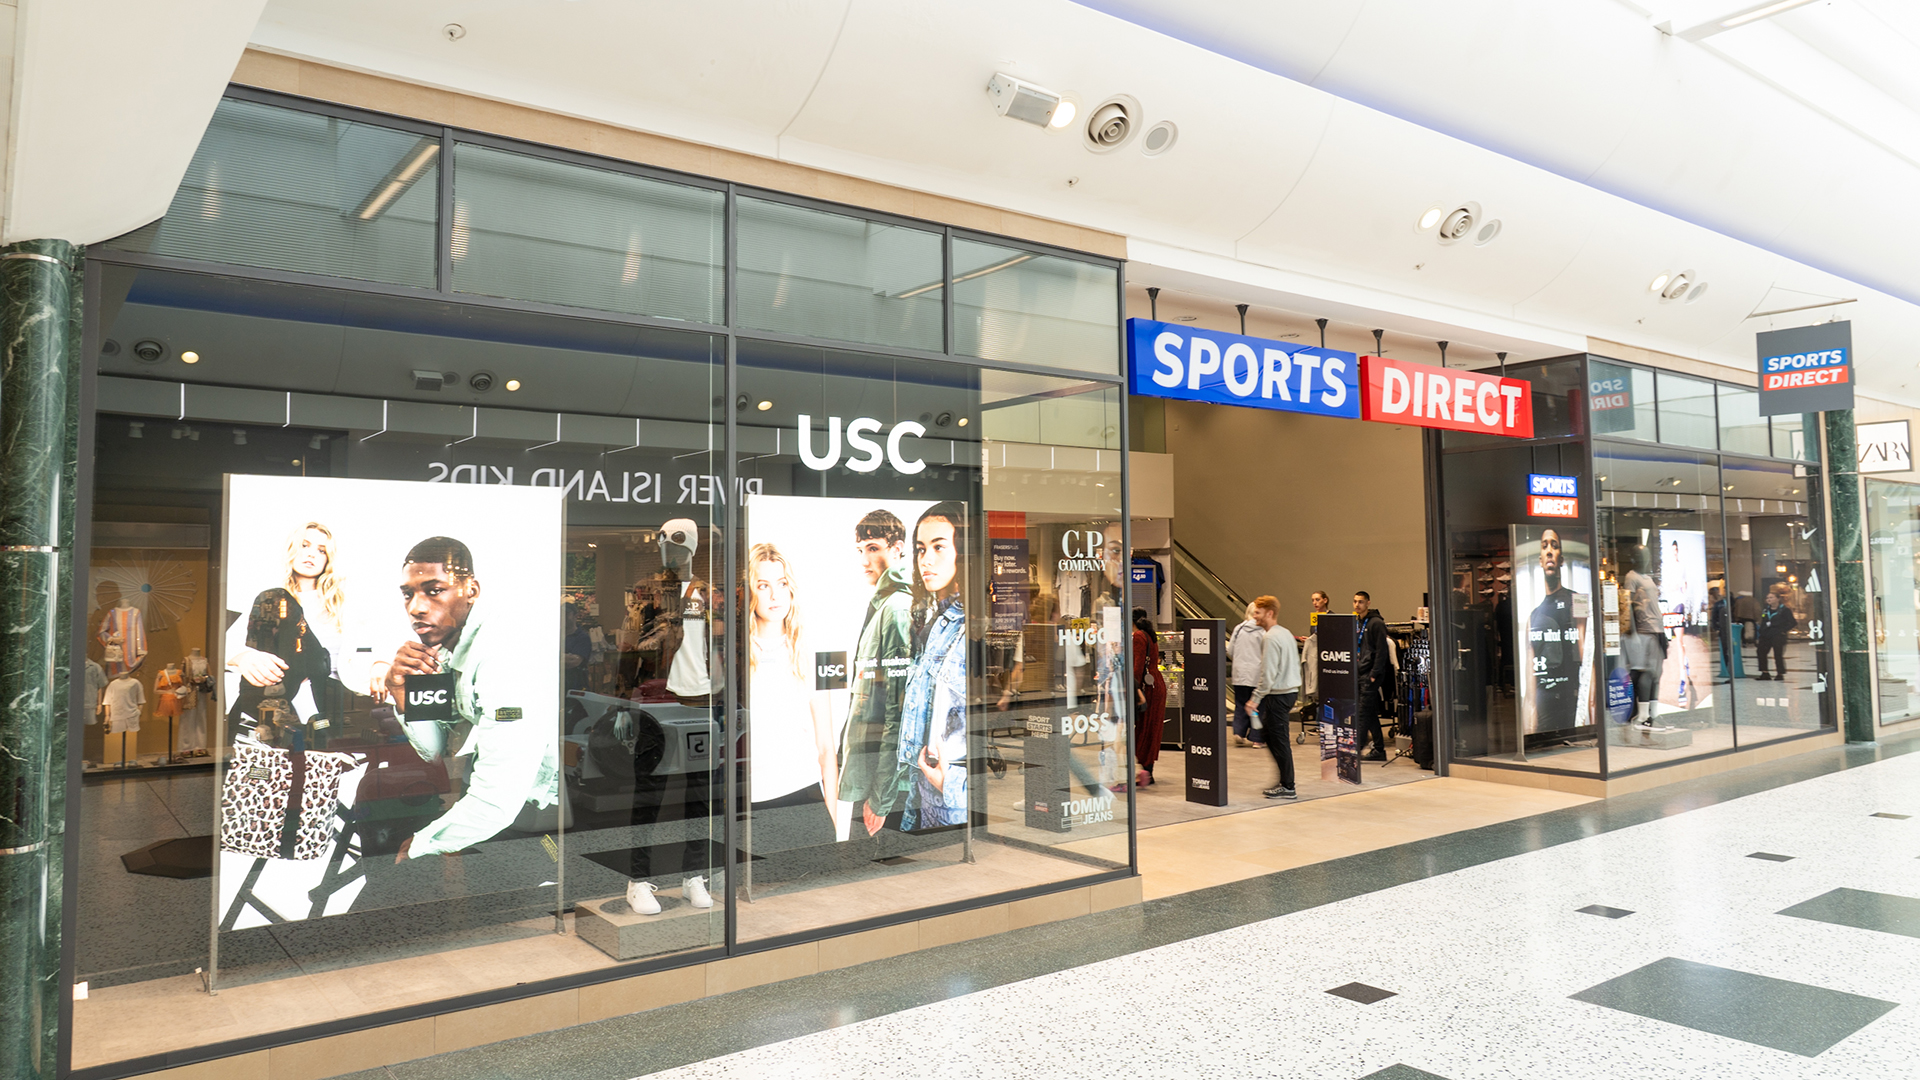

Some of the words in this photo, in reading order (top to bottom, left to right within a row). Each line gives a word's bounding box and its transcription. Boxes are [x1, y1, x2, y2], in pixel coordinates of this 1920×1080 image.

[1767, 349, 1842, 372] SPORTS
[1152, 331, 1347, 408] SPORTS
[1381, 366, 1522, 429] DIRECT
[1768, 367, 1843, 389] DIRECT
[797, 414, 927, 475] USC
[1532, 476, 1575, 495] SPORTS
[1533, 498, 1576, 515] DIRECT
[1061, 529, 1103, 559] C.P.
[1058, 559, 1107, 572] COMPANY
[1058, 627, 1110, 647] HUGO
[1193, 637, 1208, 645] USC
[881, 656, 911, 667] makes
[1320, 650, 1351, 662] GAME
[818, 664, 845, 678] USC
[409, 689, 448, 706] USC
[1028, 715, 1050, 723] SPORT
[1061, 712, 1110, 736] BOSS
[1190, 713, 1212, 724] HUGO
[1028, 722, 1052, 732] STARTS
[1031, 731, 1049, 740] HERE
[1191, 745, 1212, 756] BOSS
[1061, 796, 1114, 817] TOMMY
[1082, 811, 1114, 825] JEANS
